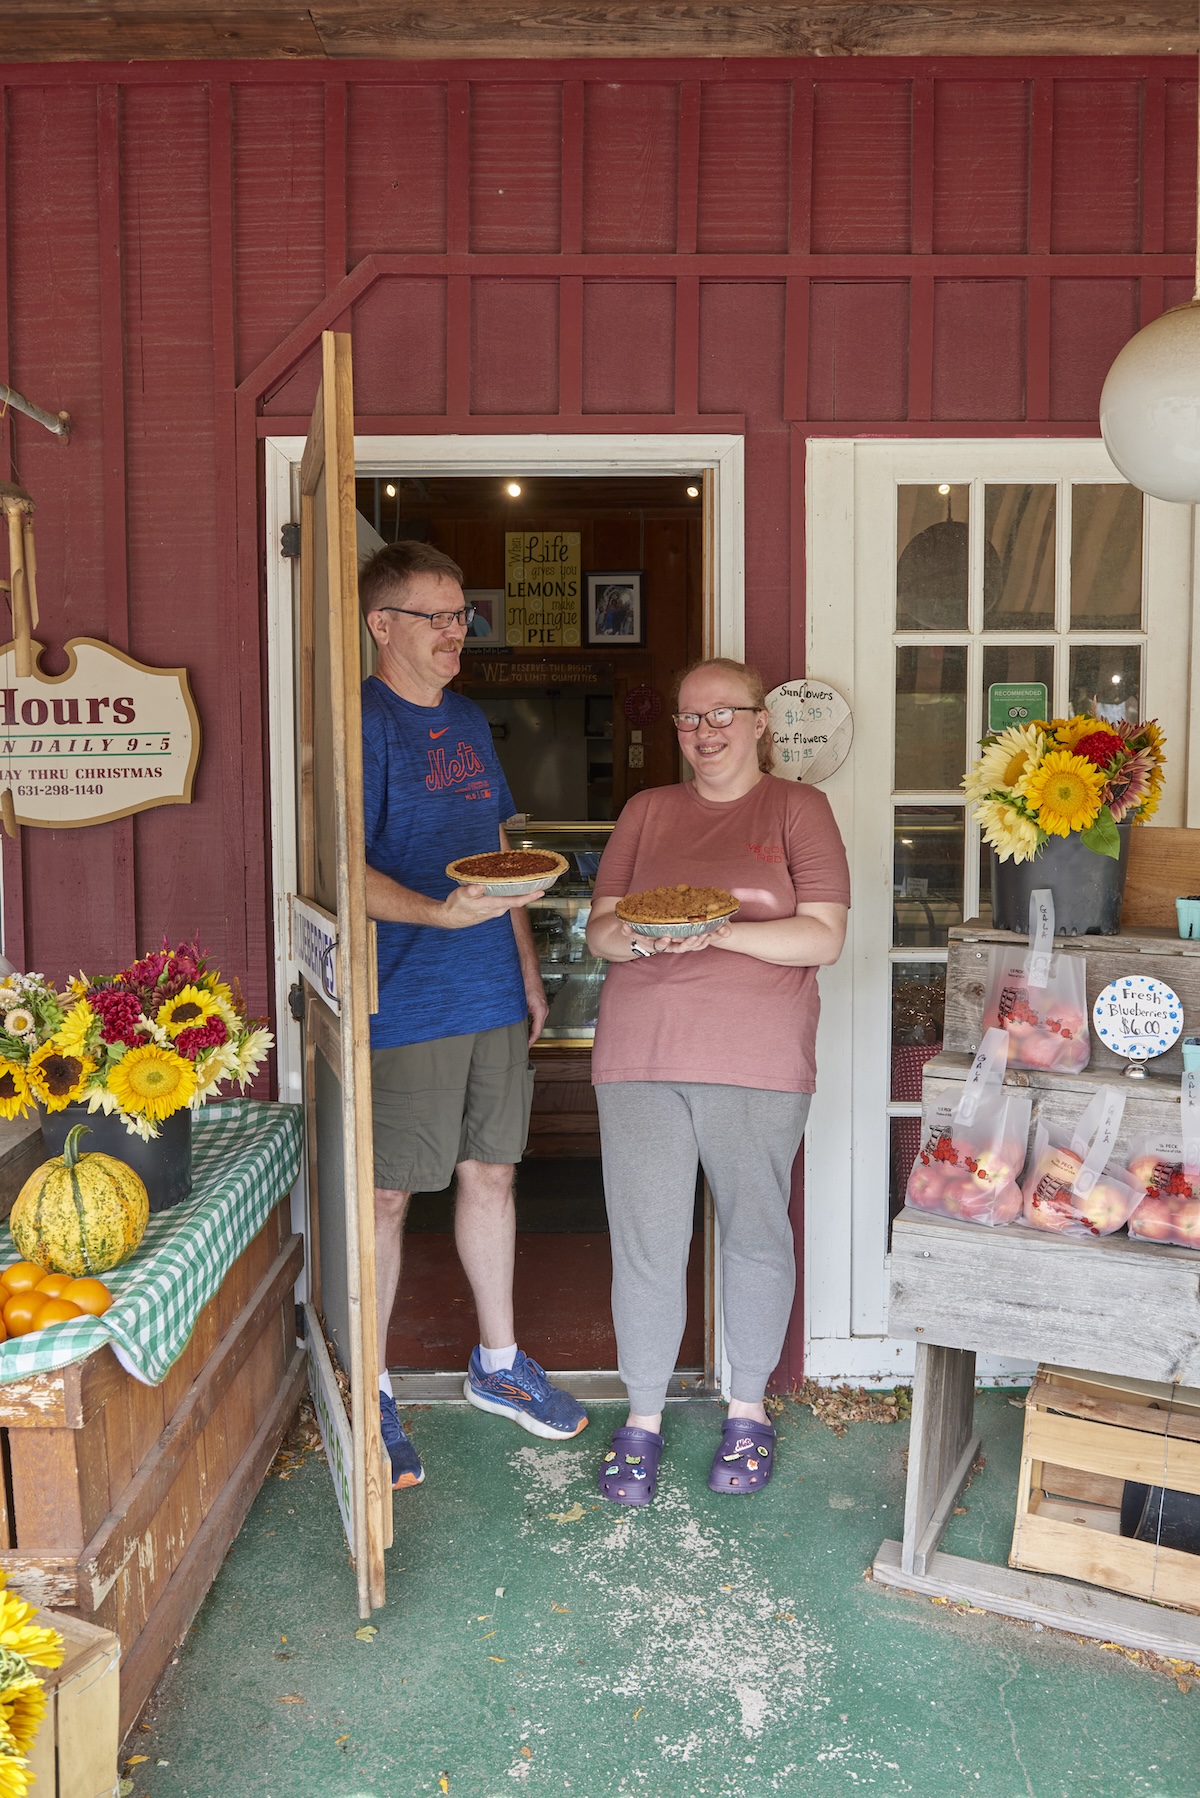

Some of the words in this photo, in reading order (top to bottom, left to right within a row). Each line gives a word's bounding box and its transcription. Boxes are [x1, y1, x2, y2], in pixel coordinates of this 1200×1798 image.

[508, 537, 522, 567] When
[522, 535, 569, 563] Life
[531, 565, 555, 580] gives
[560, 566, 577, 580] you
[508, 581, 577, 598] LEMONS
[551, 599, 575, 611] make
[508, 607, 577, 631] Meringue
[527, 629, 556, 643] PIE
[481, 663, 509, 682] WE
[511, 664, 546, 672] RESERVE
[549, 664, 565, 672] THE
[567, 664, 592, 672] RIGHT
[511, 673, 522, 682] TO
[525, 674, 547, 682] LIMIT
[551, 674, 598, 683] QUANTITIES
[779, 682, 833, 700] Sunflowers
[994, 689, 1042, 697] RECOMMENDED
[29, 738, 114, 753] DAILY
[772, 732, 789, 744] Cut
[793, 732, 828, 744] flowers
[0, 769, 22, 780] AY
[28, 768, 69, 780] THRU
[75, 767, 163, 779] CHRISTMAS
[425, 741, 485, 791] Mets
[17, 784, 104, 796] 631-298-1140
[1040, 904, 1048, 939] GALA
[1122, 988, 1161, 1004] Fresh
[1107, 1002, 1168, 1019] Blueberries
[1119, 1017, 1160, 1035] $6.00
